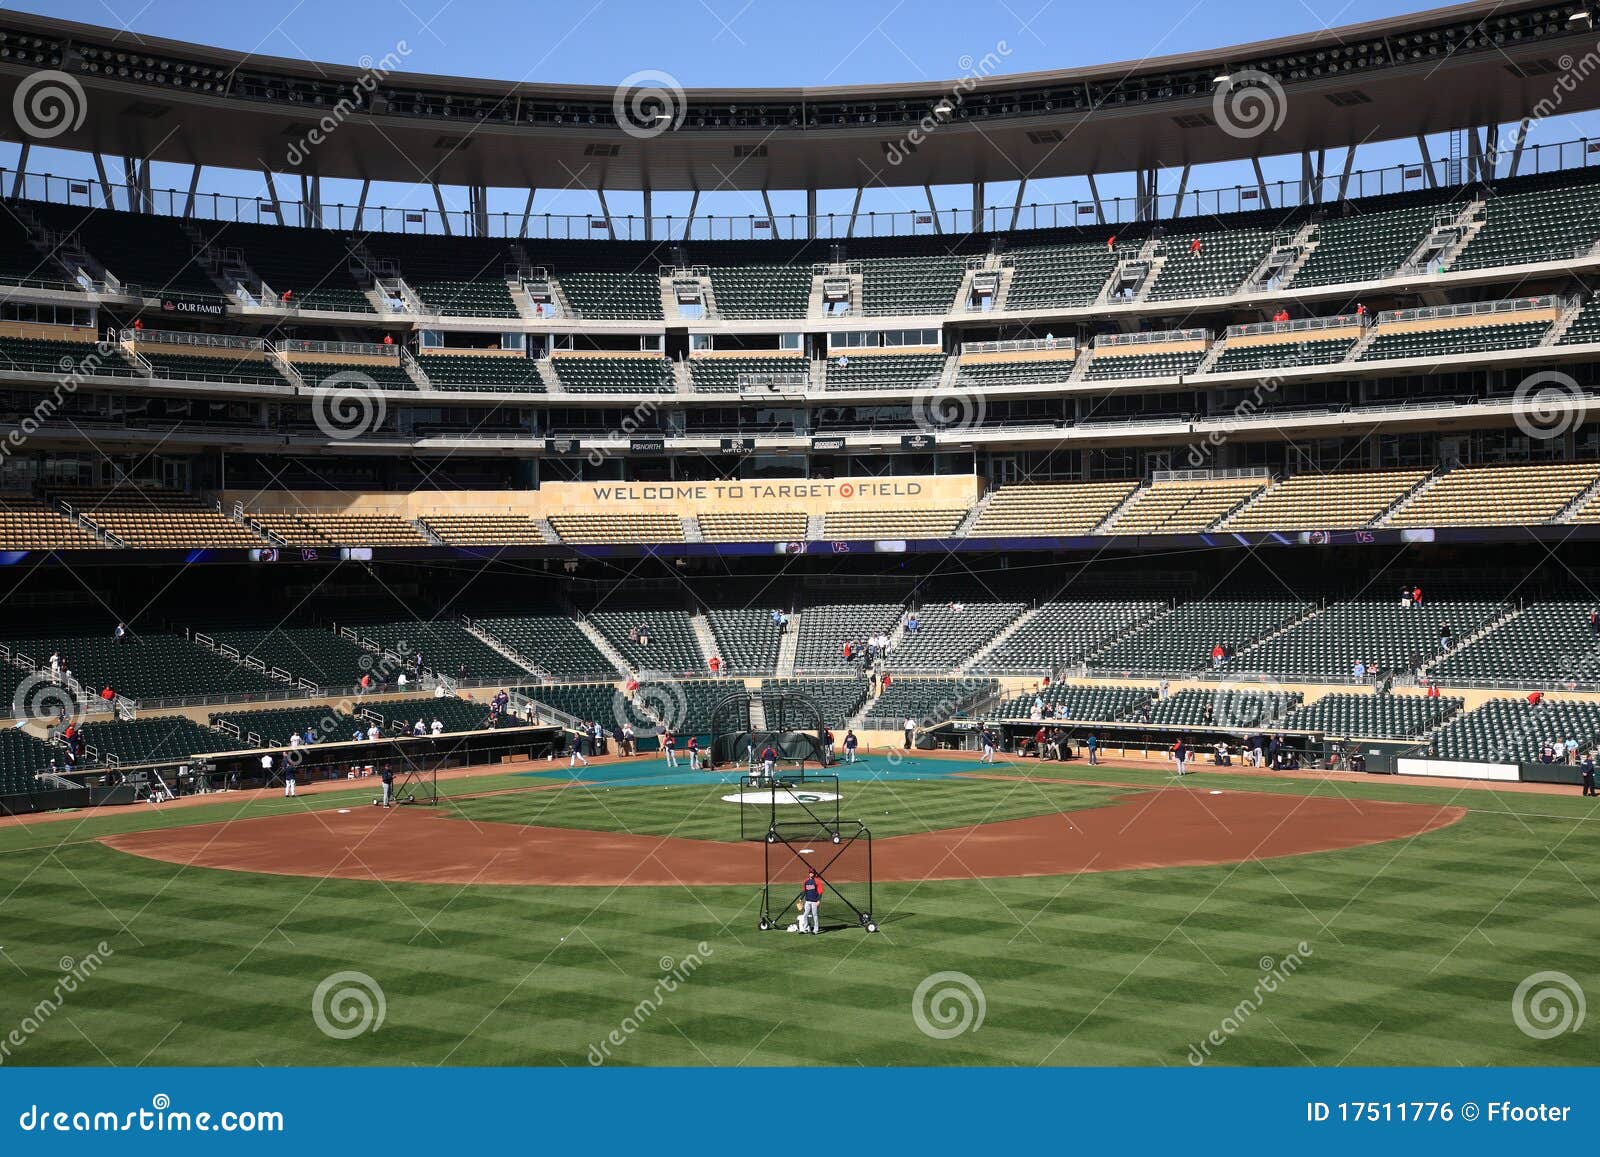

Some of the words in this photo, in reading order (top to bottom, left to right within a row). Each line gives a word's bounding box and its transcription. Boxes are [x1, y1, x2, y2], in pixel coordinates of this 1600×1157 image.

[177, 302, 196, 312] OUR
[197, 304, 223, 314] FAMILY
[593, 486, 707, 501] WELCOME
[715, 485, 744, 500] TO
[748, 484, 838, 499] TARGET
[858, 482, 922, 497] FIELD
